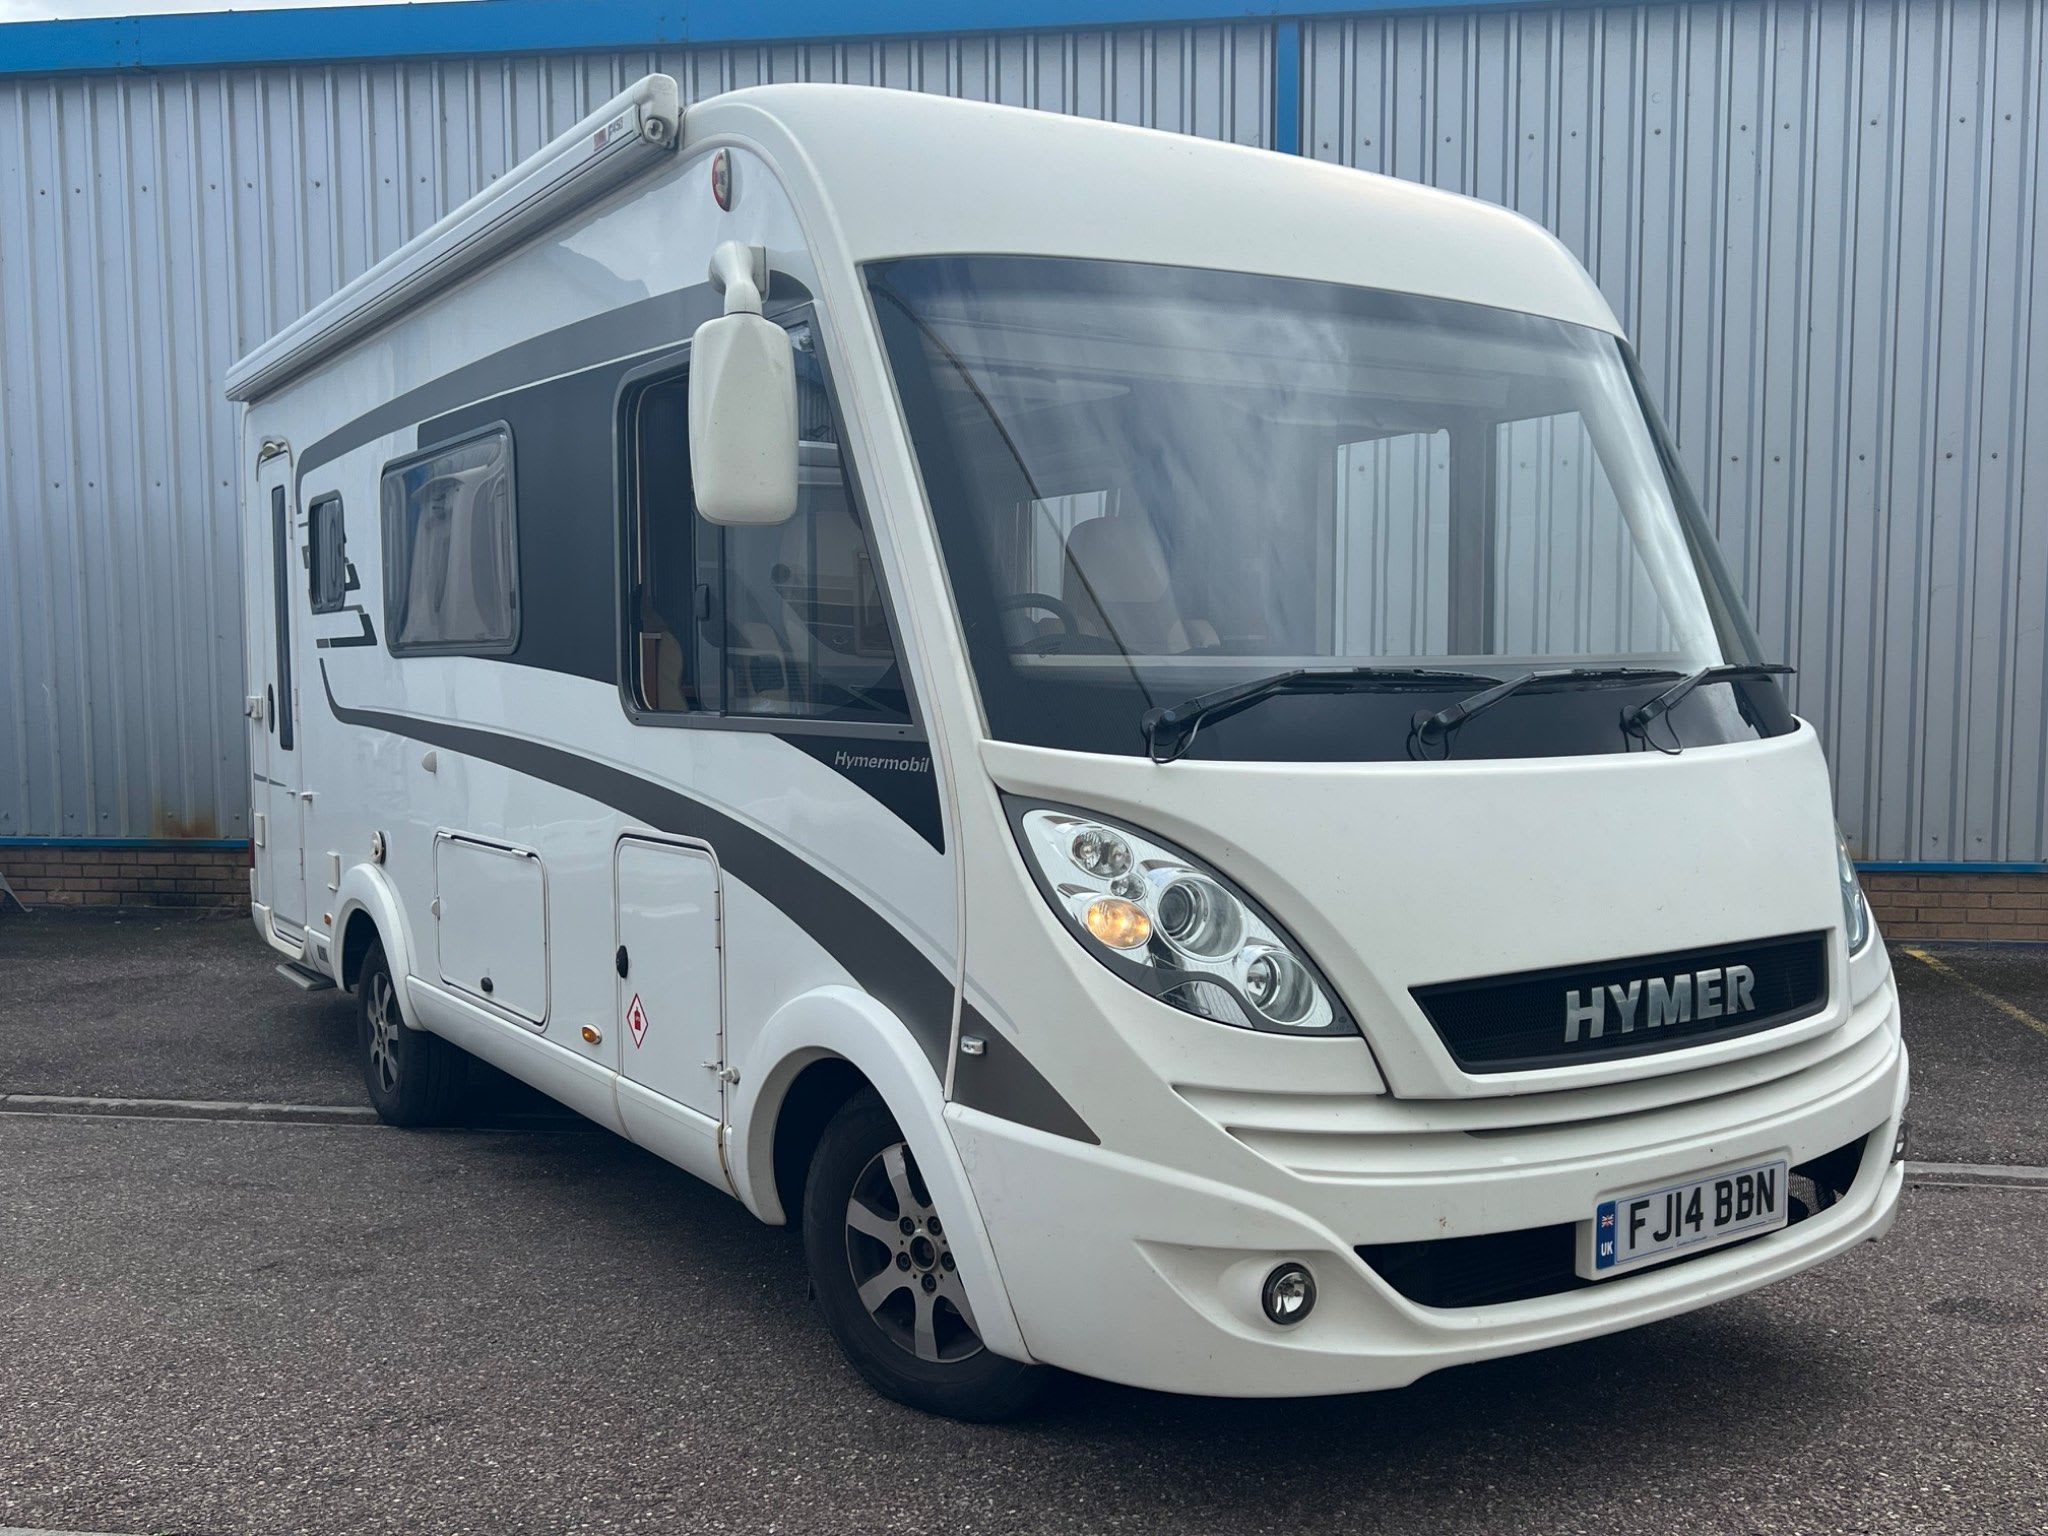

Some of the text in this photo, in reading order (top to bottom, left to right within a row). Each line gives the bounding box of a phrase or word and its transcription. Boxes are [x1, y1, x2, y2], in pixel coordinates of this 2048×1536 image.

[835, 750, 930, 773] Hymermobil
[1564, 964, 1756, 1043] HYMER
[1629, 1168, 1776, 1250] FJ14 BBN
[1601, 1240, 1614, 1257] UK
